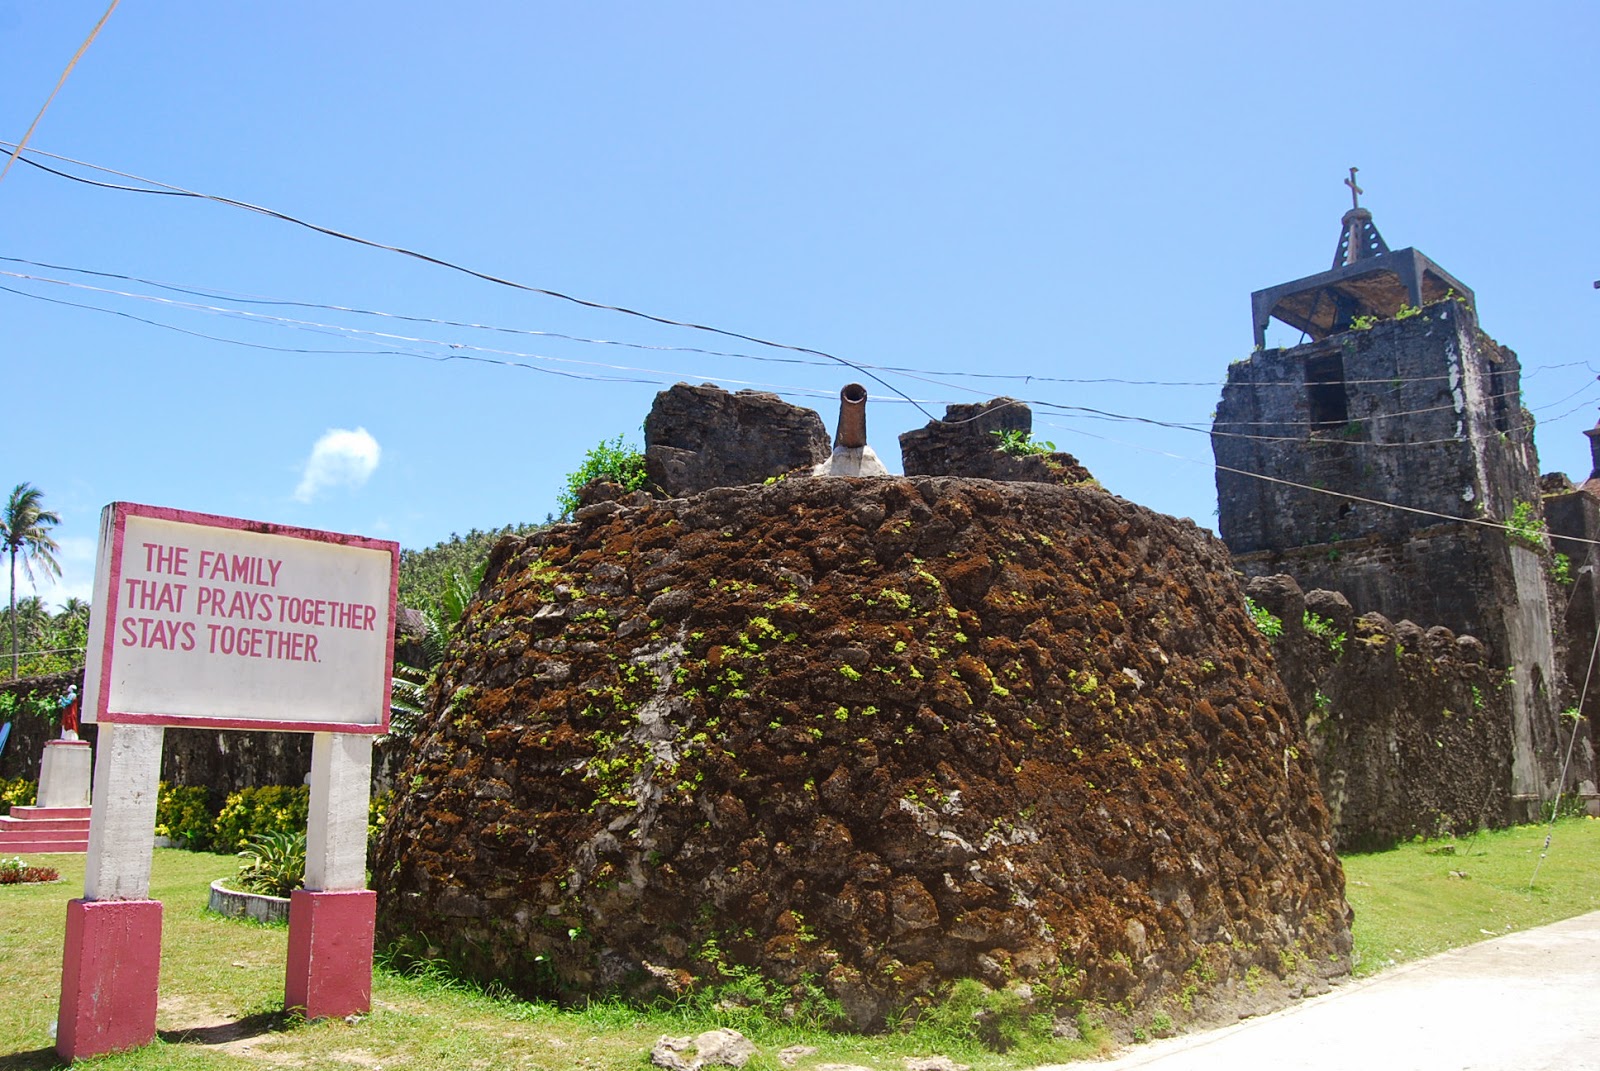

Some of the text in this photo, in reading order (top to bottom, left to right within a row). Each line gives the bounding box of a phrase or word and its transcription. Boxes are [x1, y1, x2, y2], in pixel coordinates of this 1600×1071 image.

[143, 543, 282, 587] THE FAMILY
[126, 578, 376, 631] THAT PRAYS TOGETHER
[122, 616, 321, 662] STAYS TOGETHER.
